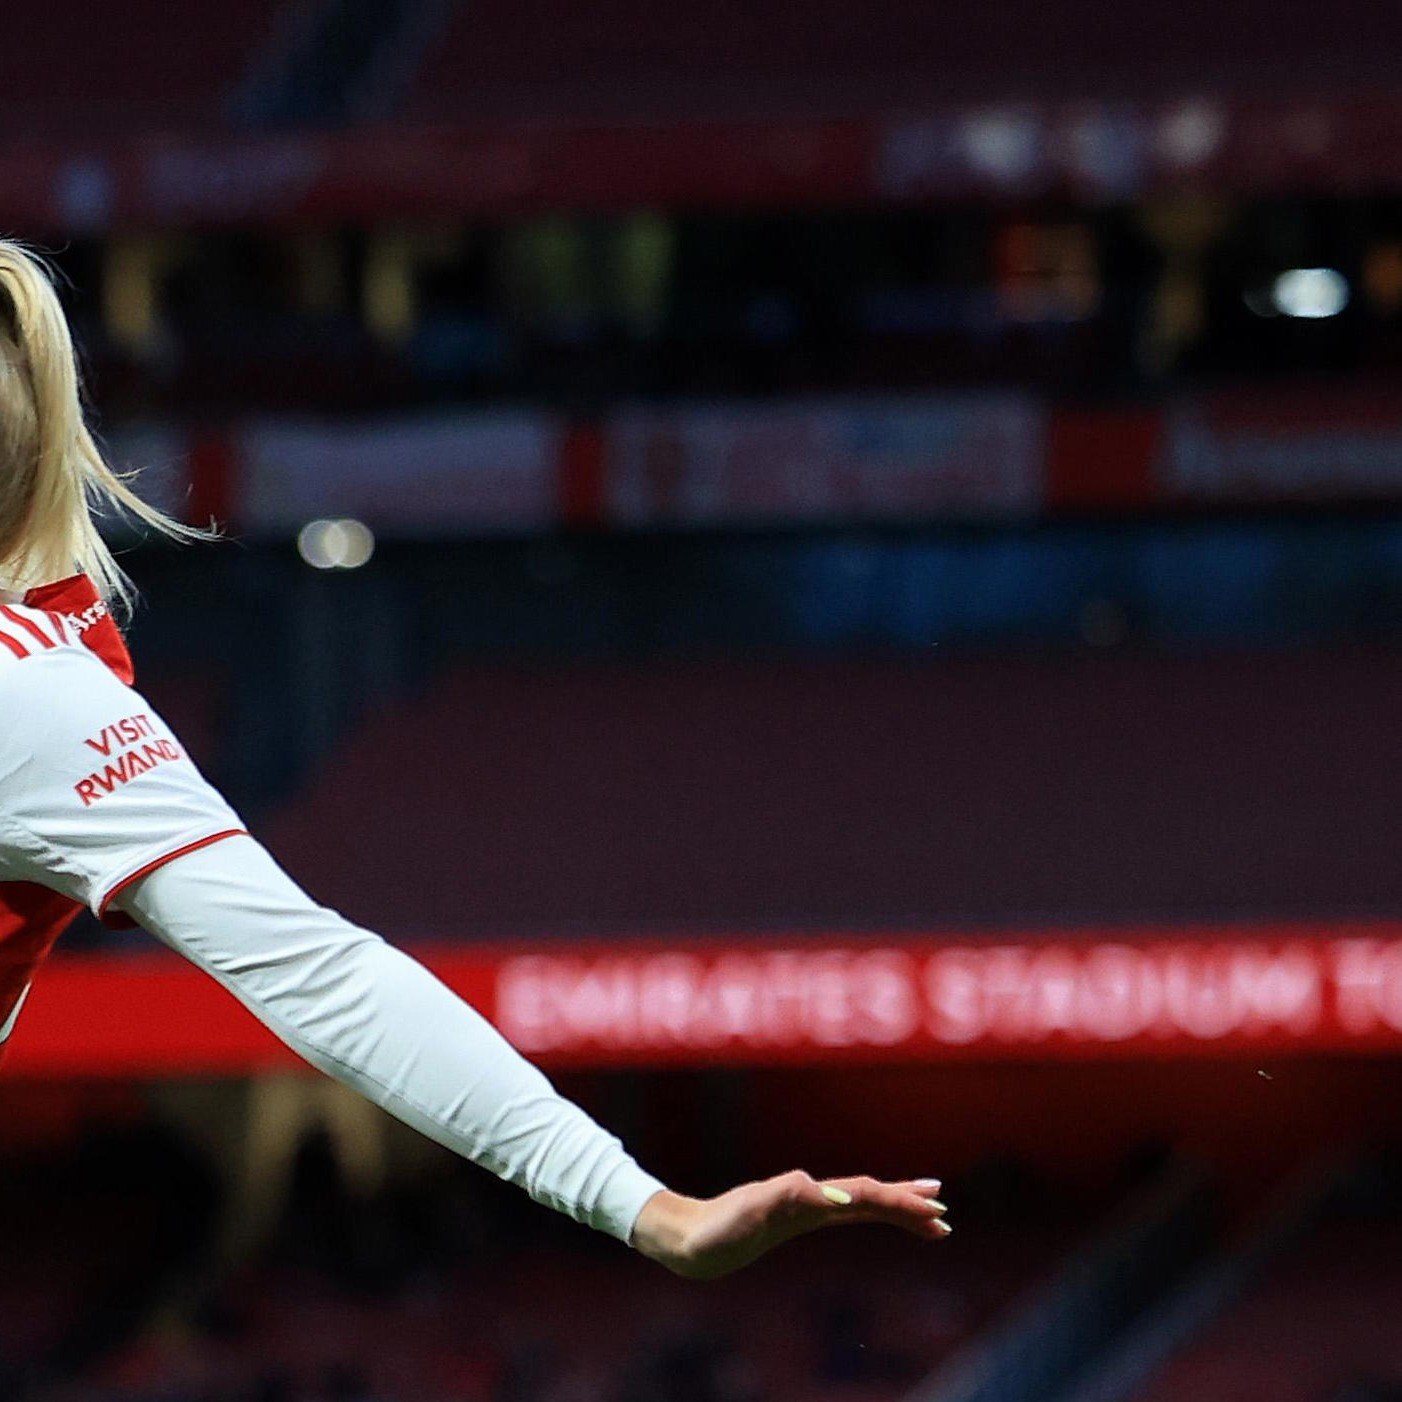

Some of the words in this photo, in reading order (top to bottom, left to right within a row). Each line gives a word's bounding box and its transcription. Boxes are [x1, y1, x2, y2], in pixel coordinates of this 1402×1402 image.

[84, 714, 157, 757] VISIT
[493, 953, 923, 1052] EMIRATES
[926, 943, 1319, 1042] STADIUM
